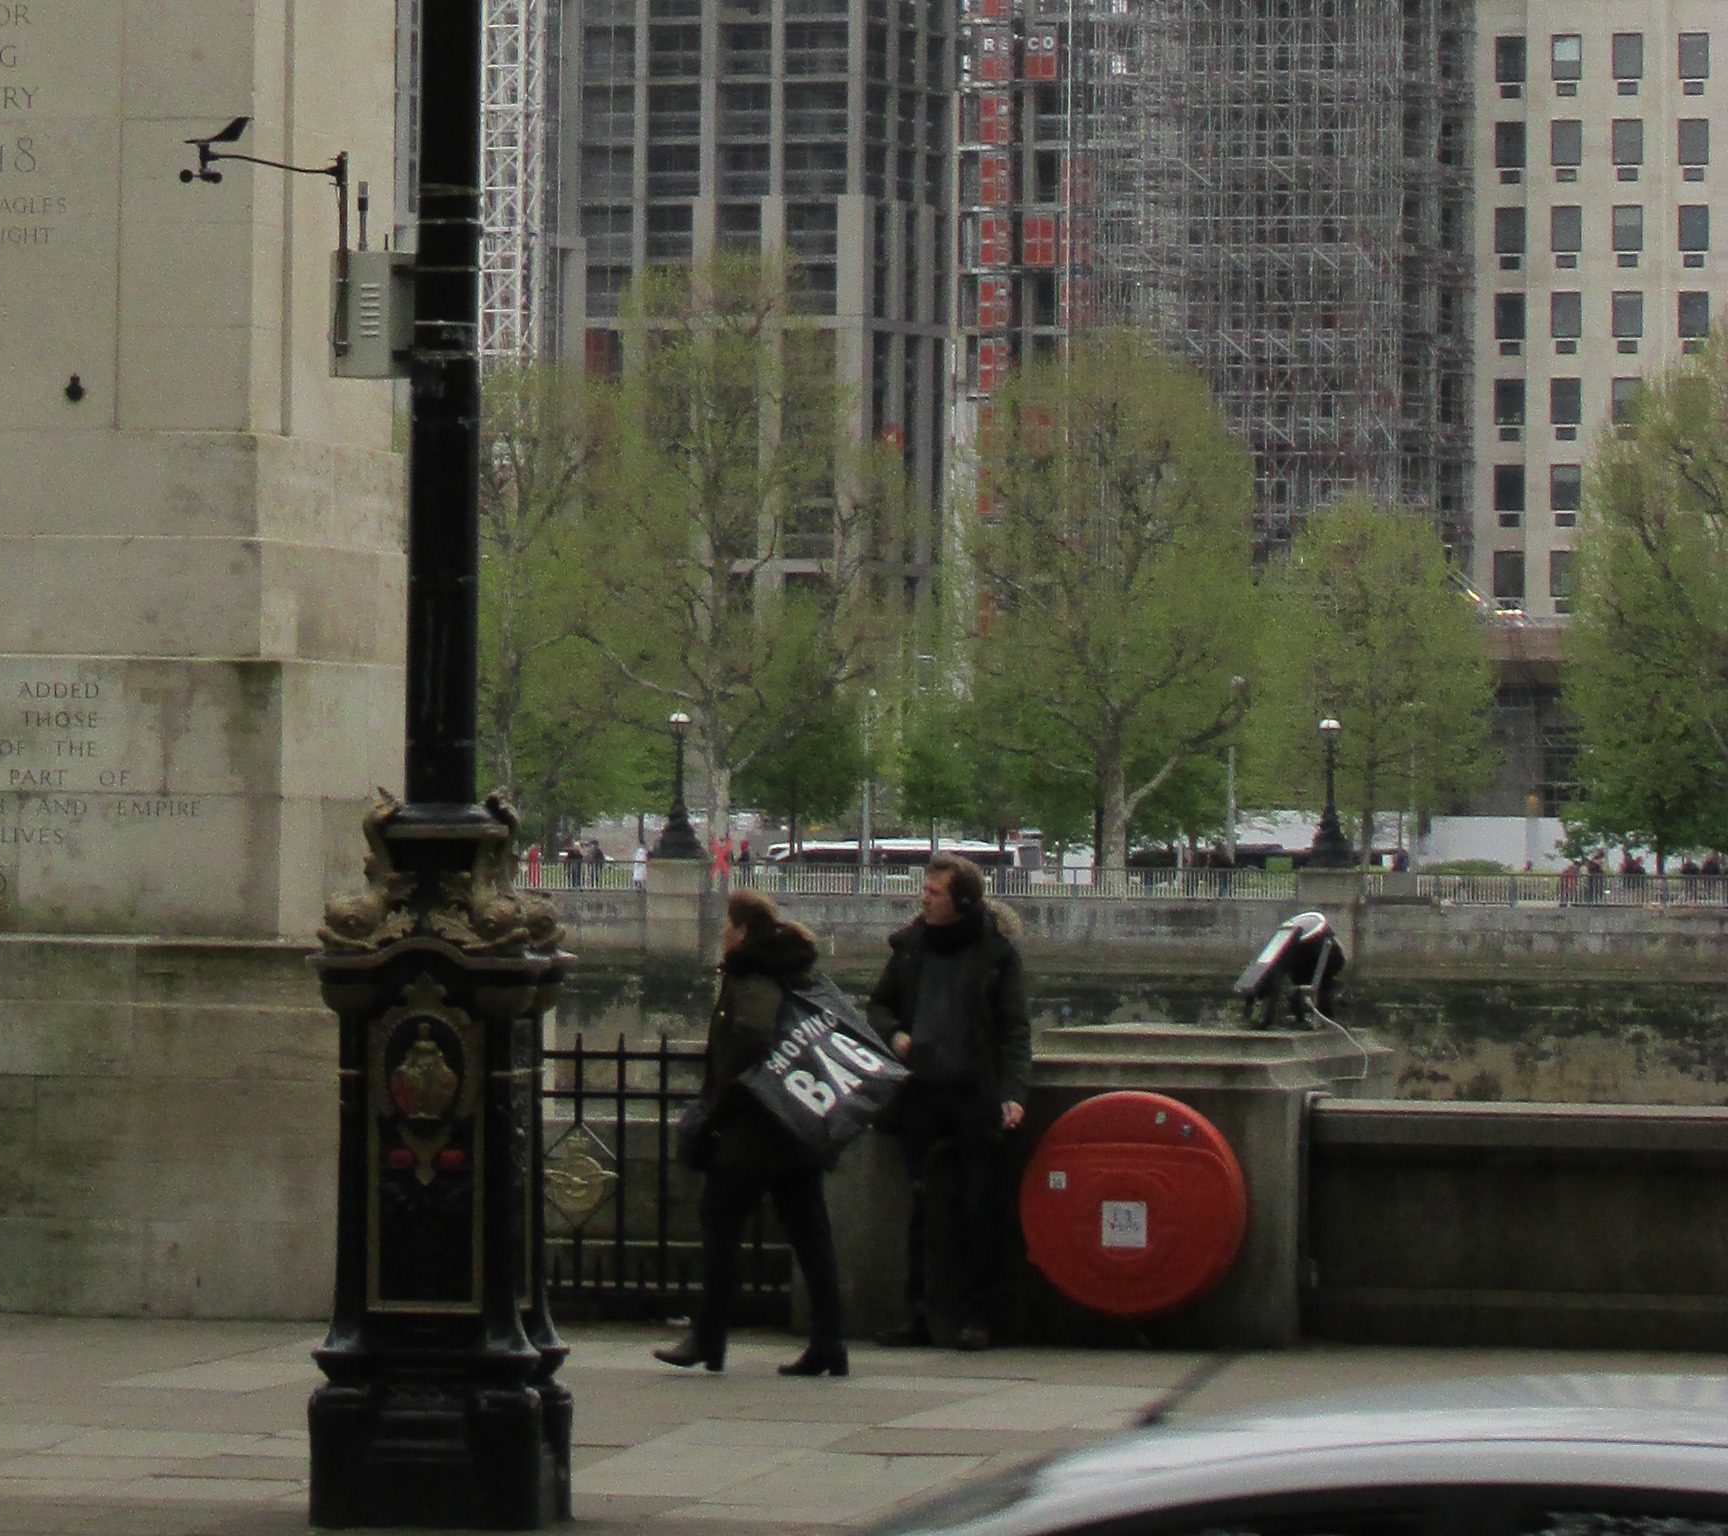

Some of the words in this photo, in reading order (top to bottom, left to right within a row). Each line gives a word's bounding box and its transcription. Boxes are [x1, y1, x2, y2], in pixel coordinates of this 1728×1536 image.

[19, 682, 99, 699] ADDED
[21, 711, 99, 729] THOSE
[54, 740, 97, 758] THE
[9, 769, 68, 787] PART
[99, 770, 133, 788] OF
[37, 799, 88, 816] AND
[116, 800, 201, 818] EMPIRE
[1, 827, 63, 845] LIVES
[783, 1032, 885, 1118] BAG
